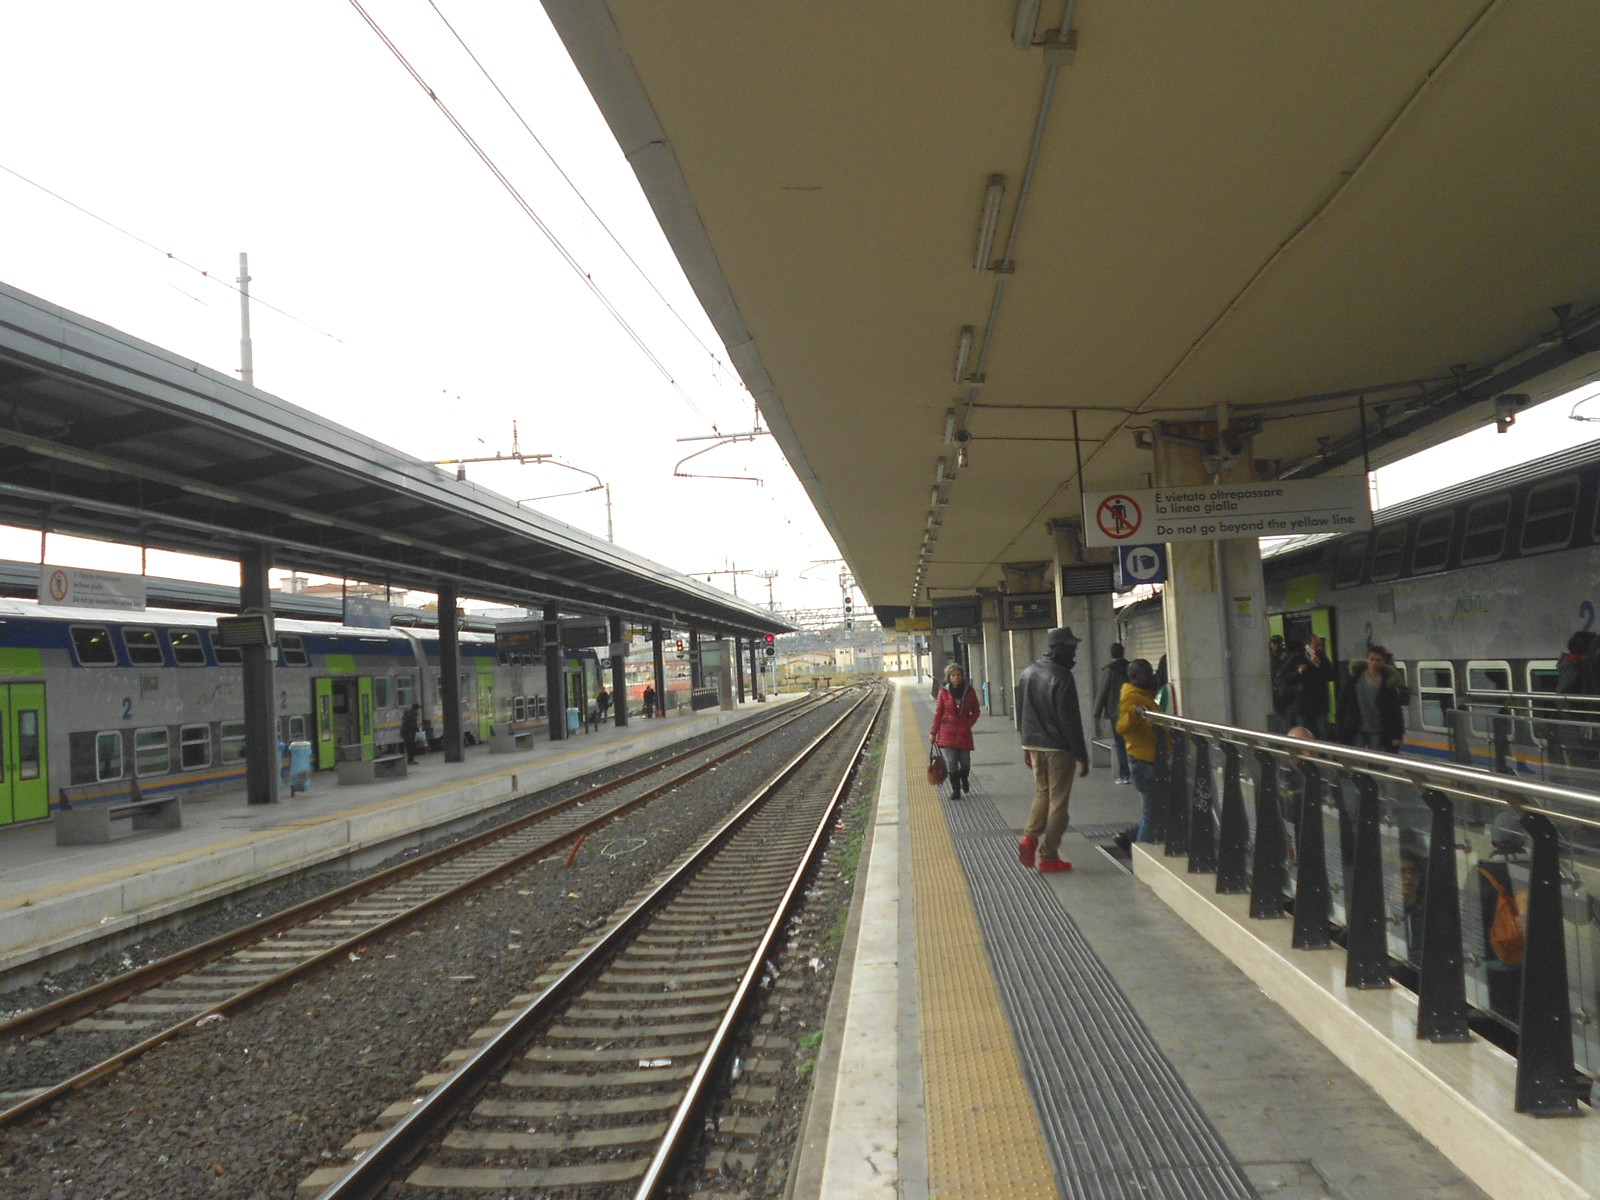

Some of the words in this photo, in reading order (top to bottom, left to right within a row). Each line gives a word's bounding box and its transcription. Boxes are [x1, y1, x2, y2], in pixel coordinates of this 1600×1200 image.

[1155, 490, 1163, 503] È
[1166, 492, 1206, 503] vietato
[1210, 488, 1283, 501] oltrepassare
[1156, 502, 1167, 514] la
[1171, 502, 1200, 513] linea
[1205, 501, 1238, 513] gialla
[1157, 525, 1173, 536] Do
[1177, 524, 1196, 535] not
[1200, 525, 1216, 536] go
[1219, 519, 1264, 533] beyond
[1268, 518, 1286, 529] the
[1290, 515, 1329, 530] yellow
[1332, 514, 1355, 525] line
[122, 697, 132, 720] 2
[280, 691, 288, 709] 2
